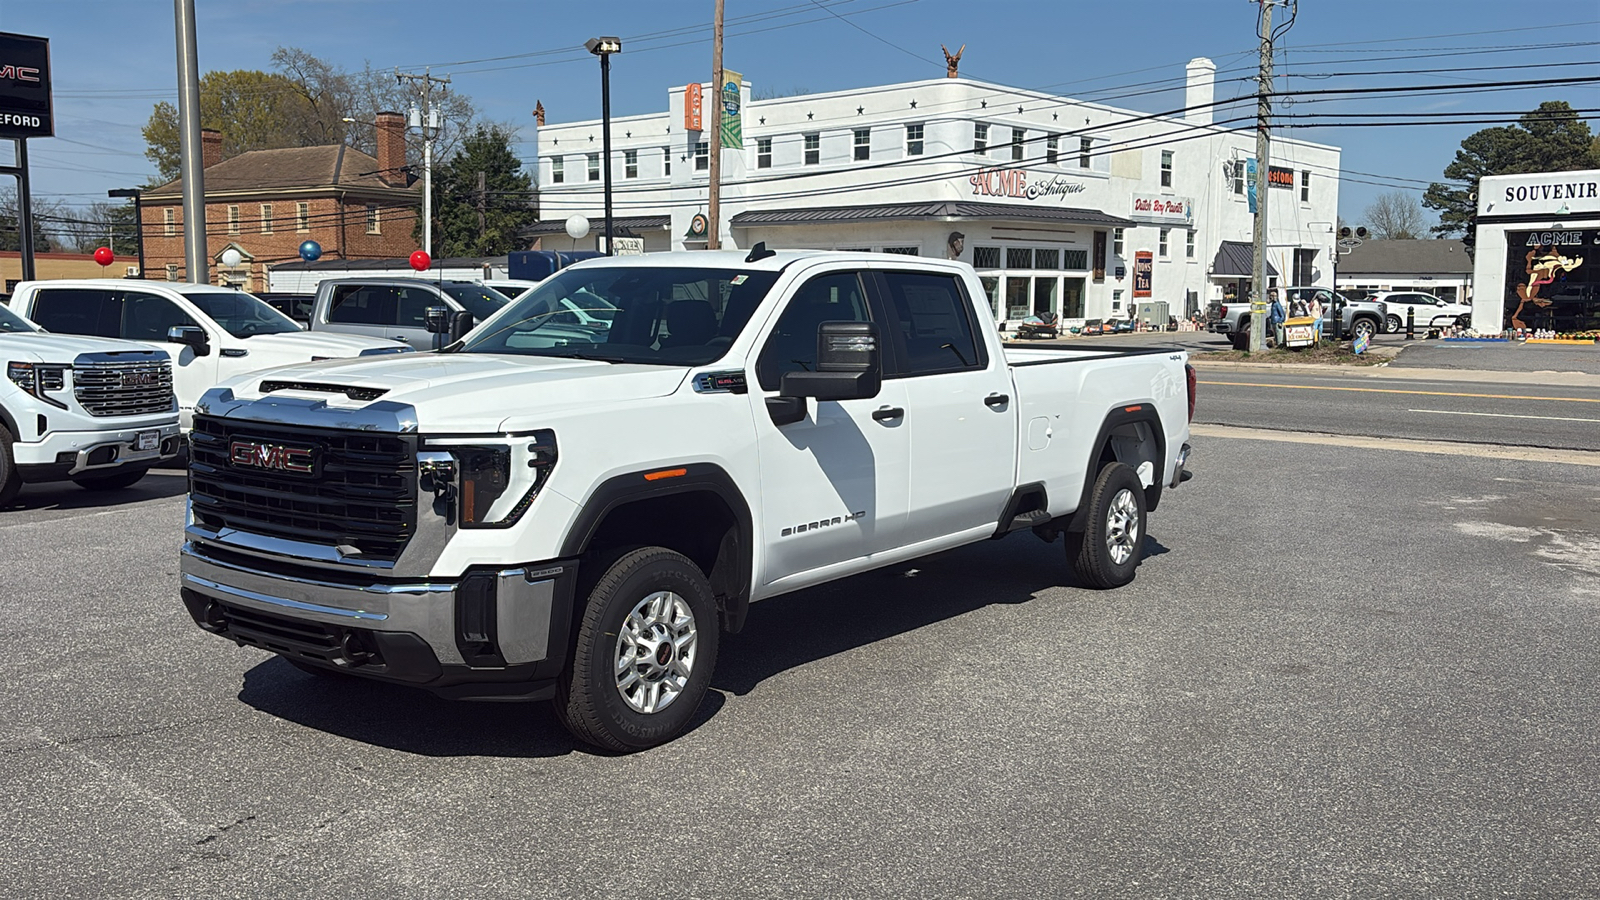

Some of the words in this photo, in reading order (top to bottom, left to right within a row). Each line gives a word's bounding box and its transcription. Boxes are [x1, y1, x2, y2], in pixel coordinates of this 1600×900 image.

[692, 86, 700, 127] ACME
[970, 167, 1027, 198] ACME
[1505, 182, 1598, 202] SOUVENIR
[1135, 198, 1151, 211] Dutch
[1153, 199, 1165, 215] Boy
[1165, 200, 1183, 213] Paints
[1526, 232, 1582, 246] ACME
[1137, 277, 1149, 288] TEA
[231, 442, 312, 473] GMC
[781, 516, 841, 537] SIERRA
[844, 510, 866, 523] HD
